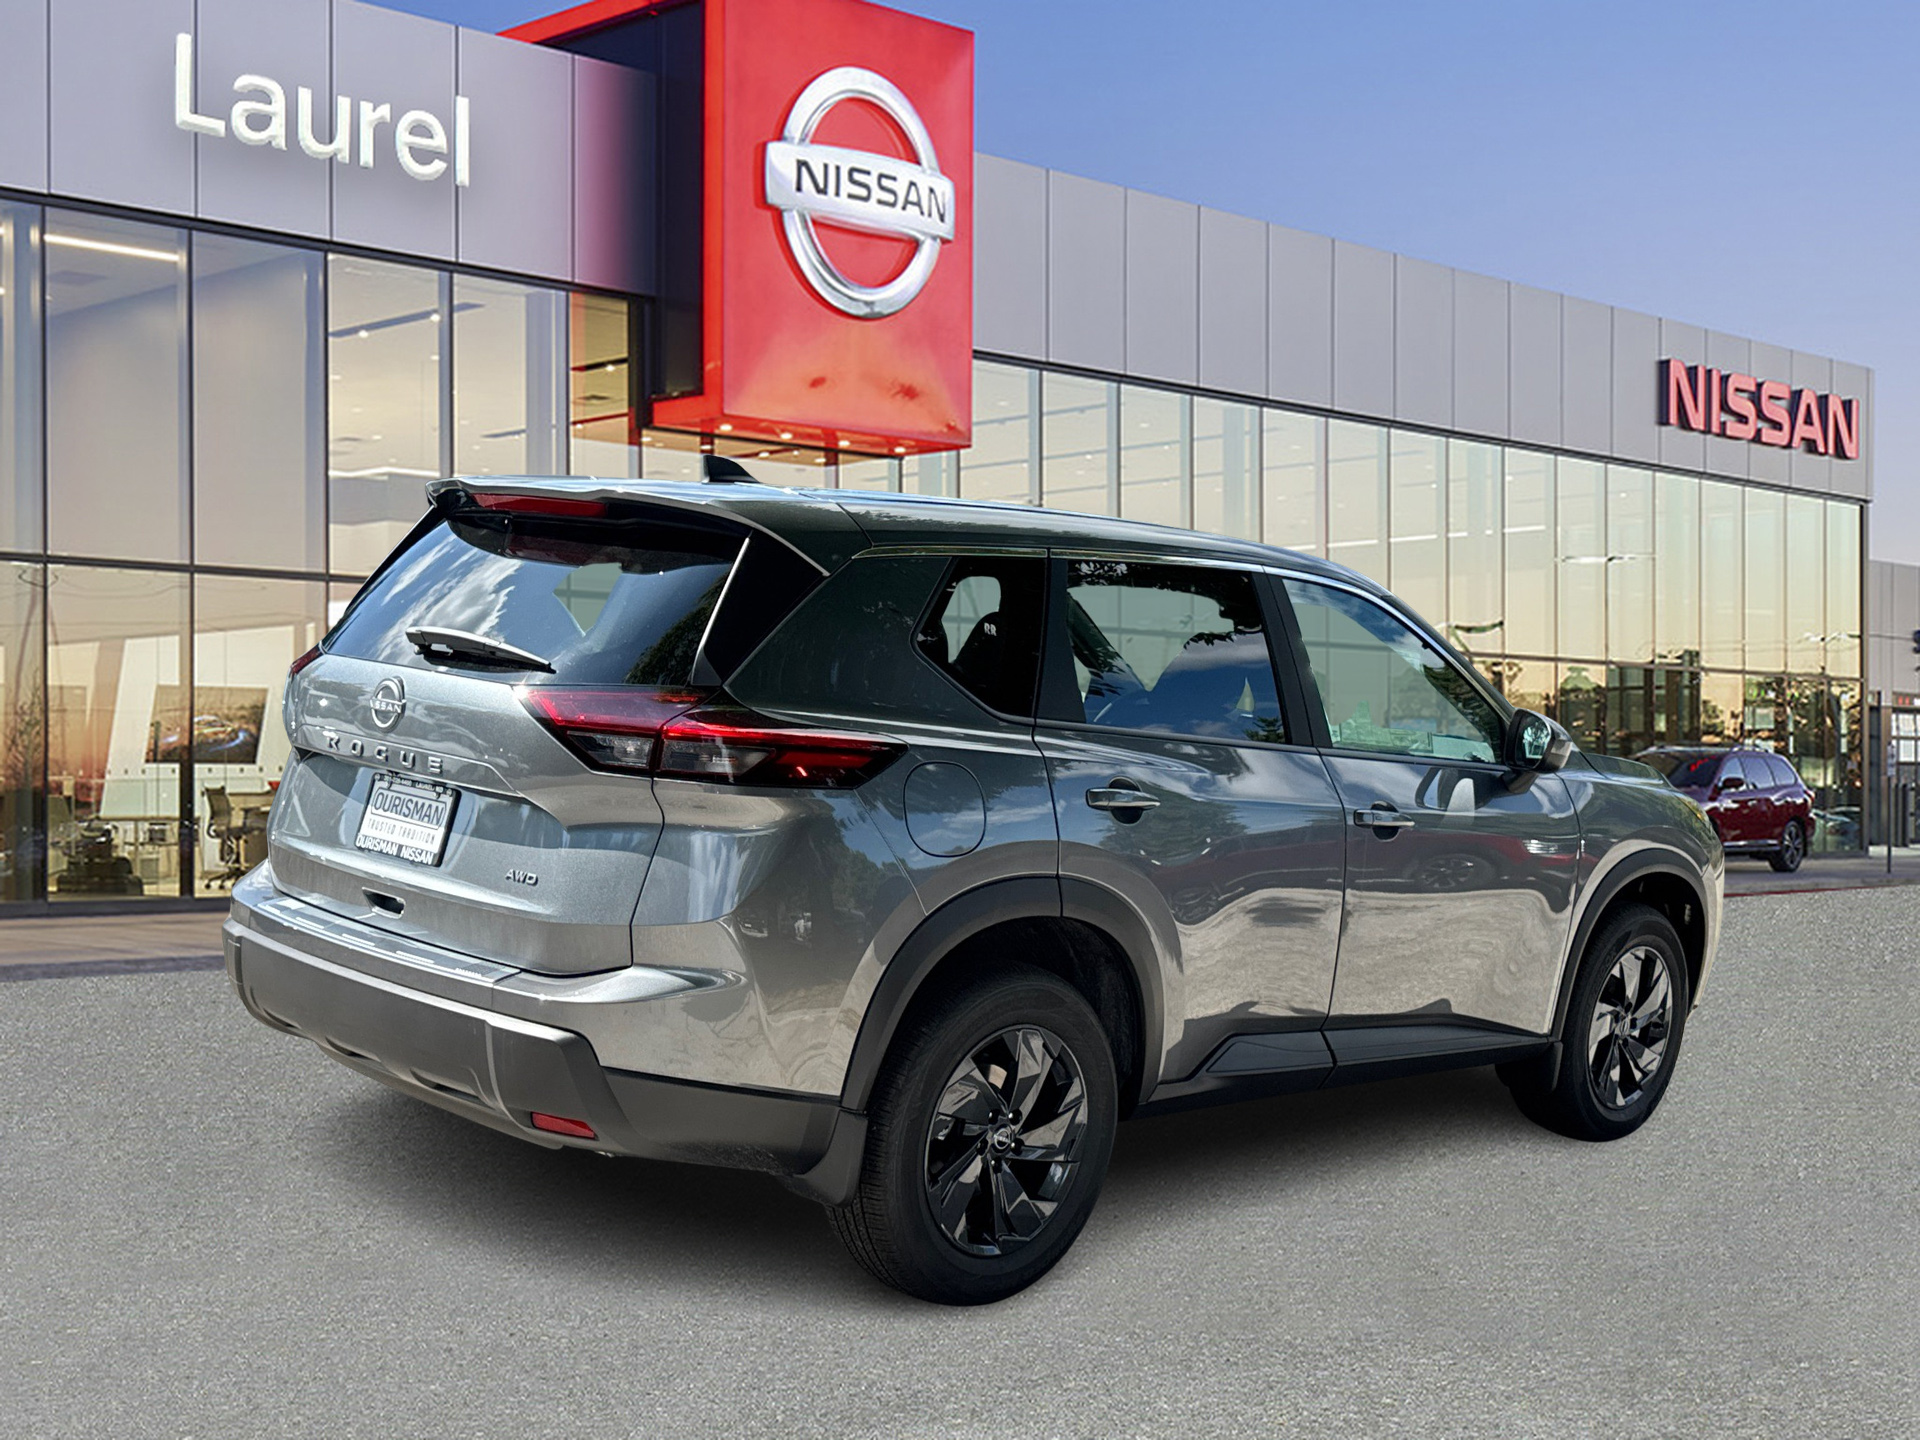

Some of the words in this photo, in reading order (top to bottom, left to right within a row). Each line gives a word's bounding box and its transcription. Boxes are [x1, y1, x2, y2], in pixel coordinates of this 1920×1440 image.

[175, 32, 470, 188] Laurel
[795, 158, 946, 224] NISSAN
[1657, 357, 1860, 460] NISSAN
[323, 730, 443, 775] ROGUE
[368, 817, 397, 836] TRUSTED
[374, 791, 445, 827] OURISMAN
[355, 833, 399, 857] OURISMAN
[400, 844, 435, 866] NISSAN
[505, 868, 538, 887] AWD
